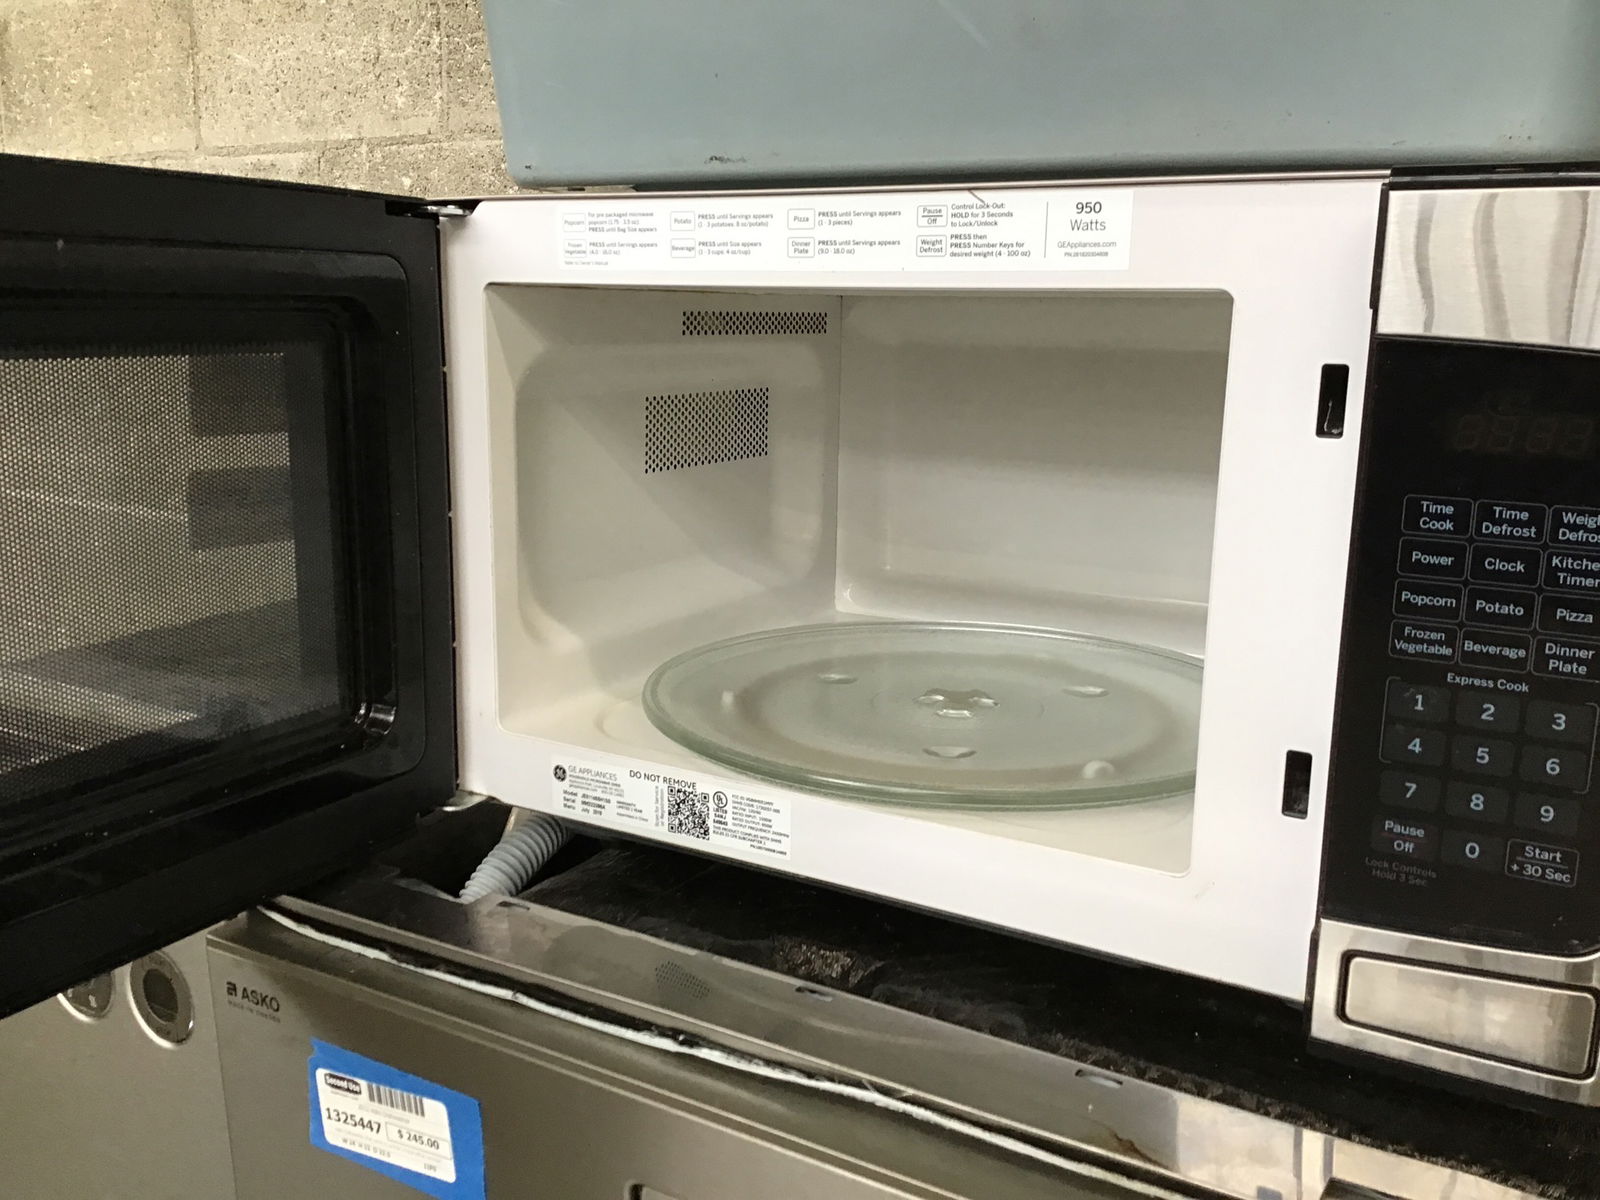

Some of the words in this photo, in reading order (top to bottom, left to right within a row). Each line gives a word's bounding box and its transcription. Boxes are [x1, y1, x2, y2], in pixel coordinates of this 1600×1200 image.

[852, 210, 877, 218] Servings
[981, 210, 986, 218] 3
[986, 210, 1014, 218] Seconds
[1076, 201, 1102, 214] 950
[674, 217, 692, 225] Potato
[752, 212, 774, 220] appears
[832, 219, 853, 227] pieces)
[927, 217, 938, 225] Off
[1070, 218, 1107, 232] Watts
[852, 239, 877, 247] Servings
[877, 239, 901, 247] appears
[919, 246, 943, 254] Defrost
[920, 239, 942, 247] Weight
[999, 241, 1014, 250] Keys
[973, 250, 994, 258] weight
[1420, 500, 1455, 515] Time
[1492, 506, 1529, 521] Time
[1419, 517, 1454, 531] Cook
[1482, 522, 1536, 538] Defrost
[1411, 550, 1455, 567] Power
[1484, 557, 1525, 573] Clock
[1557, 572, 1600, 588] Timer
[1401, 590, 1456, 608] Popcorn
[1475, 600, 1524, 616] Potato
[1555, 608, 1594, 623] Pizza
[1403, 626, 1446, 642] Frozen
[1394, 639, 1453, 657] Vegetable
[1464, 640, 1527, 659] Beverage
[1544, 643, 1596, 660] Dinner
[1548, 660, 1588, 676] Plate
[1446, 672, 1494, 690] Express
[1497, 679, 1530, 693] Cook
[1413, 694, 1424, 711] 1
[1480, 704, 1496, 721] 2
[1552, 713, 1566, 730] 3
[1407, 737, 1422, 754] 4
[1475, 747, 1490, 765] 5
[568, 765, 577, 774] GE
[578, 767, 618, 781] APPLIANCES
[1546, 758, 1560, 775] 6
[629, 769, 642, 779] DO
[643, 773, 661, 783] NOT
[662, 776, 697, 790] REMOVE
[1404, 782, 1417, 798] 7
[1470, 793, 1484, 811] 8
[1540, 805, 1555, 822] 9
[1384, 820, 1425, 838] Pause
[1393, 840, 1416, 853] Off
[1524, 846, 1562, 863] Start
[1365, 857, 1389, 868] Lock
[1392, 861, 1437, 878] Controls
[1523, 863, 1541, 877] 30
[1545, 866, 1571, 883] Sec
[1372, 868, 1397, 880] Hold
[1399, 873, 1406, 882] 3
[1408, 875, 1428, 887] Sec
[241, 986, 281, 1013] ASKO
[326, 1074, 348, 1089] Second
[325, 1107, 381, 1134] 1325447
[397, 1129, 404, 1139] $
[406, 1131, 440, 1150] 245.00
